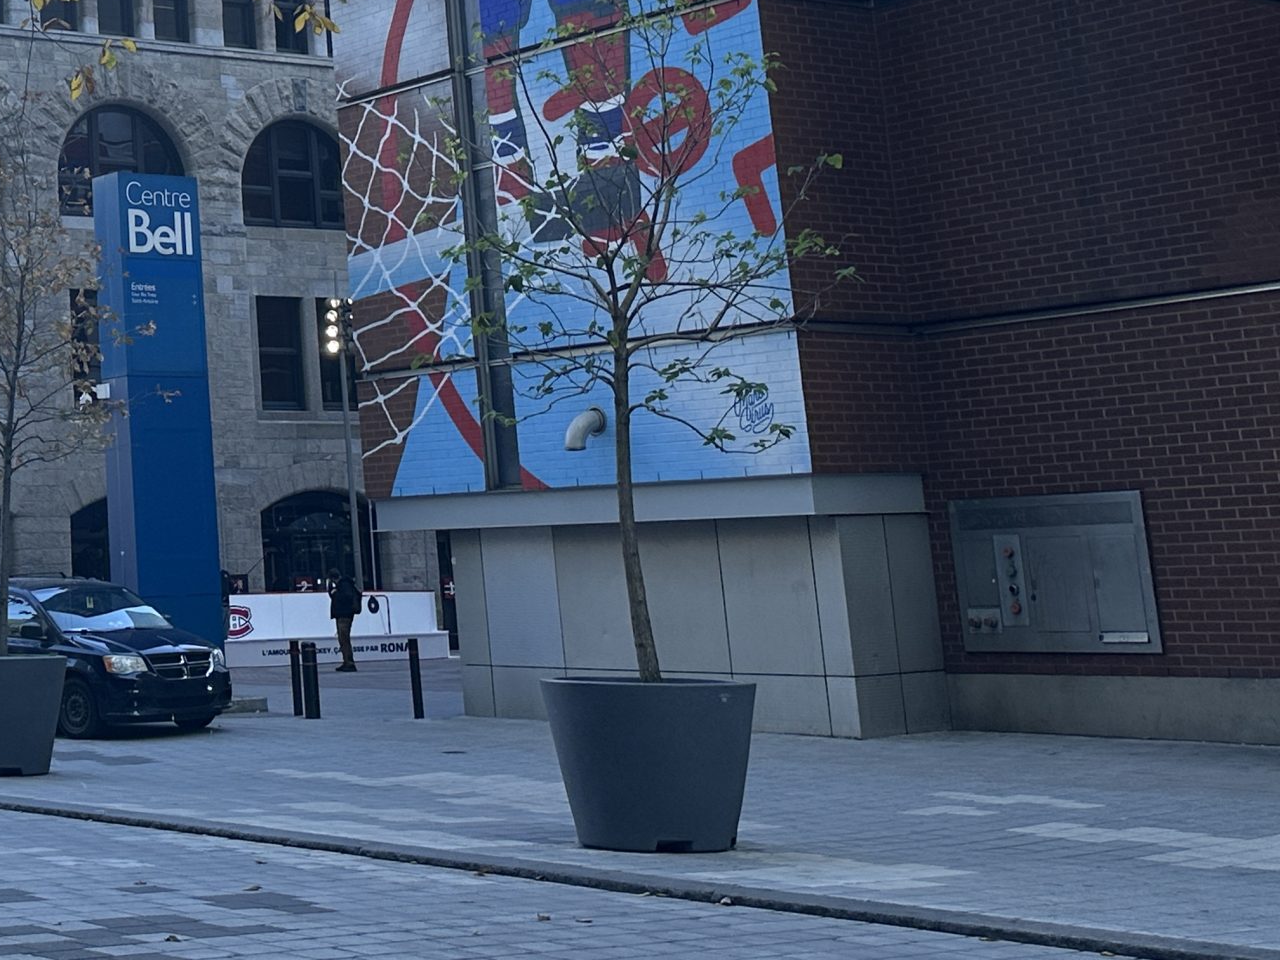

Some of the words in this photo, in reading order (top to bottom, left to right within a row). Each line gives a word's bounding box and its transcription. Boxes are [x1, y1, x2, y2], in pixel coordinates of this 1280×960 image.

[125, 180, 192, 208] Centre
[127, 208, 194, 256] Bell
[365, 645, 379, 653] PAR
